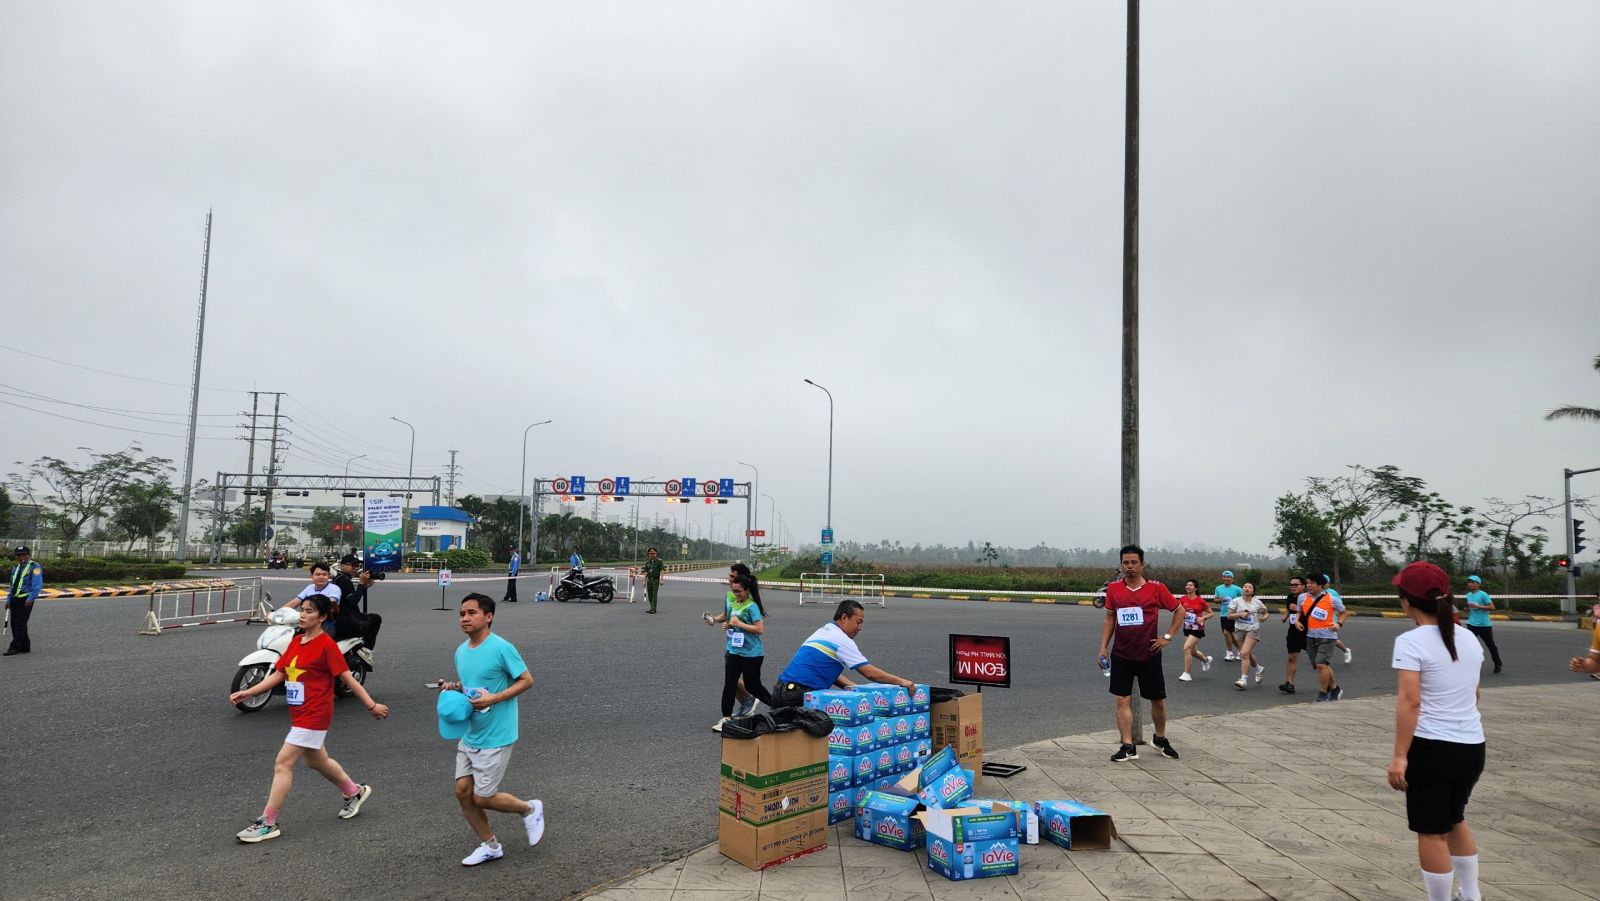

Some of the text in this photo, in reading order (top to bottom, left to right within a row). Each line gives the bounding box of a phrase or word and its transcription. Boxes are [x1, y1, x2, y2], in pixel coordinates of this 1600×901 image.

[1122, 613, 1138, 622] 1281
[873, 696, 888, 706] Vie
[828, 732, 850, 745] aVie
[877, 821, 904, 838] laVie
[982, 848, 1014, 864] laVie
